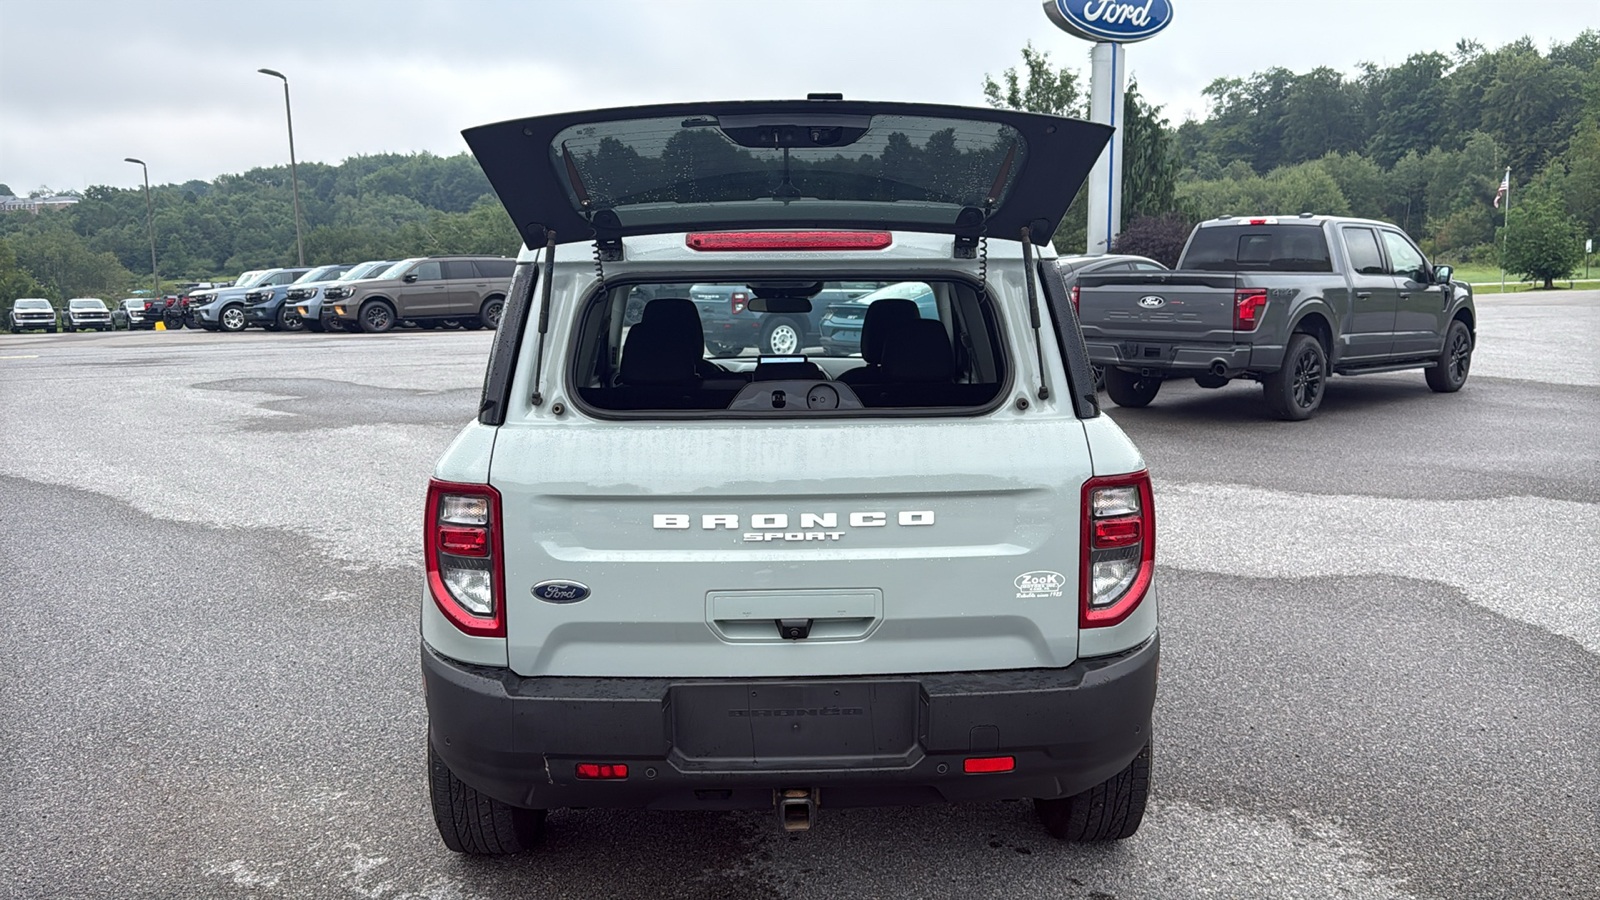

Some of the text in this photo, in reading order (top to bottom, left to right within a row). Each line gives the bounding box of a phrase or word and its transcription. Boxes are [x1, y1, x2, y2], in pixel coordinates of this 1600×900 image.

[1103, 309, 1203, 324] F-150
[653, 511, 935, 529] BRONCO
[743, 531, 846, 541] SPORT
[544, 584, 576, 599] Ford
[728, 707, 863, 717] BRONCO
